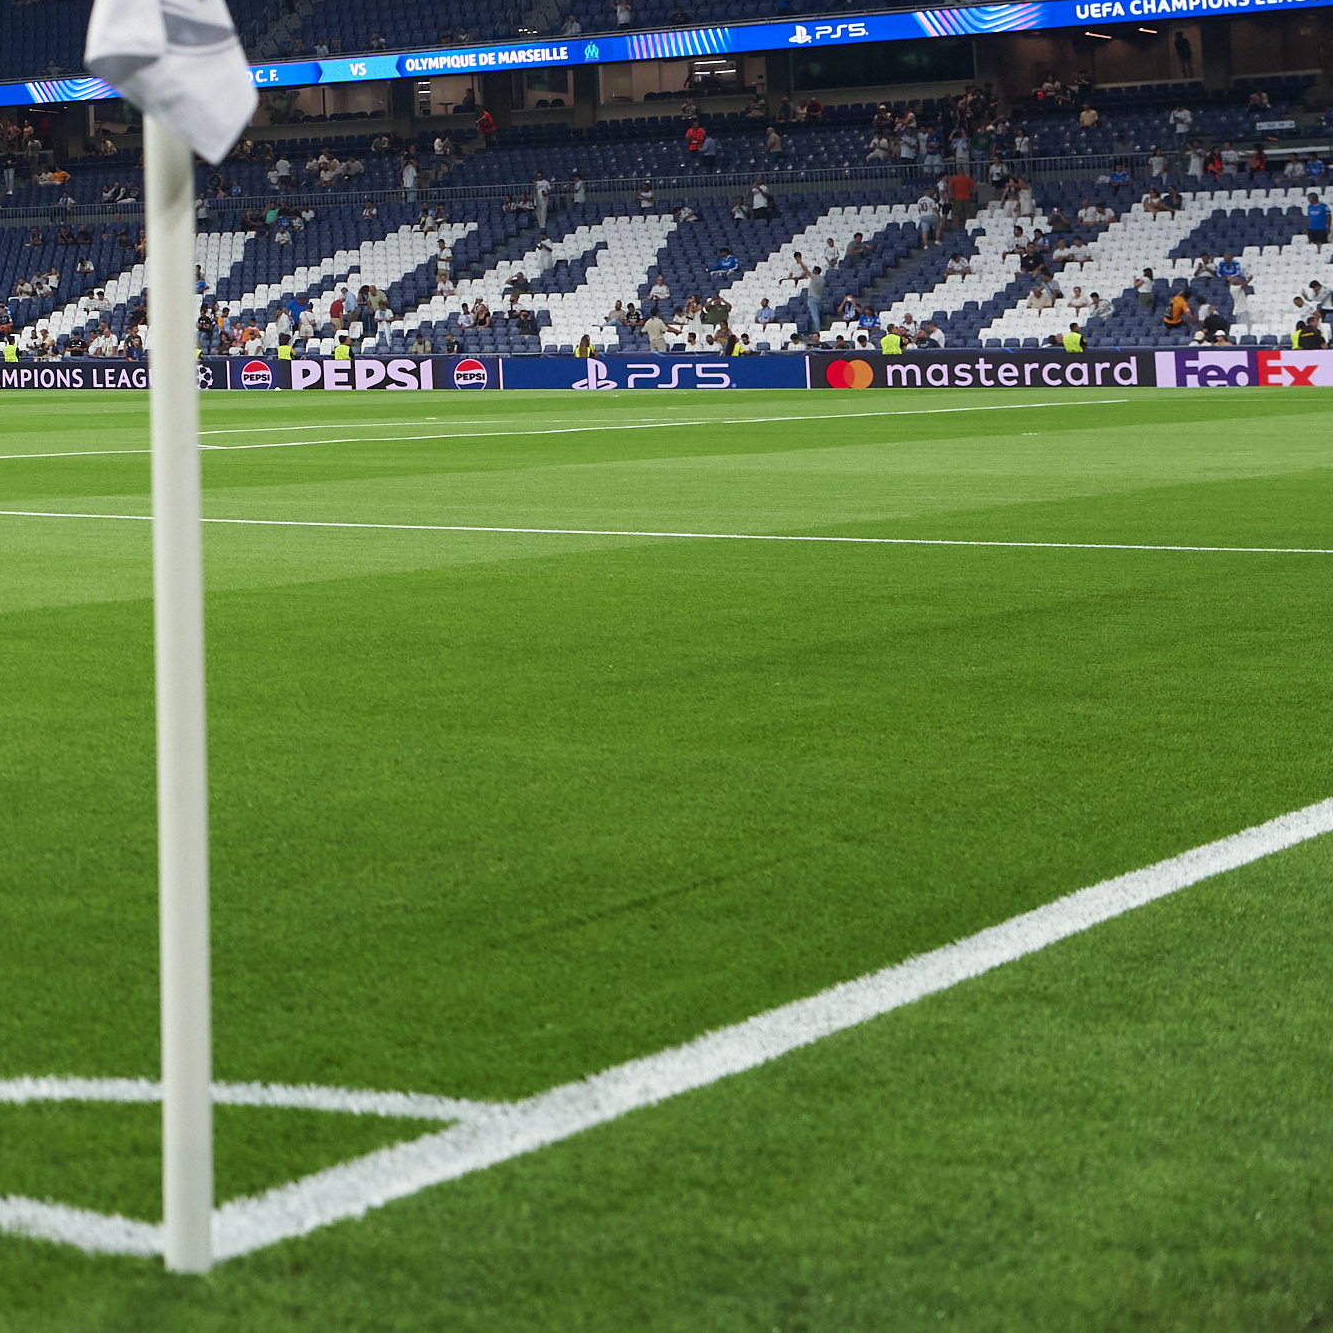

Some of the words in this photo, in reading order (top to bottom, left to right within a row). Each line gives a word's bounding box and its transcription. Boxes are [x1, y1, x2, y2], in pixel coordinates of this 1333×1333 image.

[1076, 3, 1125, 19] UEFA
[815, 23, 865, 39] PS5
[406, 54, 477, 71] OLYMPIQUE
[479, 52, 497, 65] DE
[498, 47, 568, 64] MARSEILLE
[255, 70, 267, 83] C.
[270, 69, 279, 82] F.
[349, 63, 367, 76] VS
[241, 372, 271, 383] PEPSI
[291, 360, 433, 390] PEPSI
[455, 372, 485, 383] PEPSI
[627, 363, 730, 388] PS5
[886, 355, 1138, 387] mastercard
[1175, 351, 1320, 386] FedEx
[92, 368, 153, 388] LEAG
